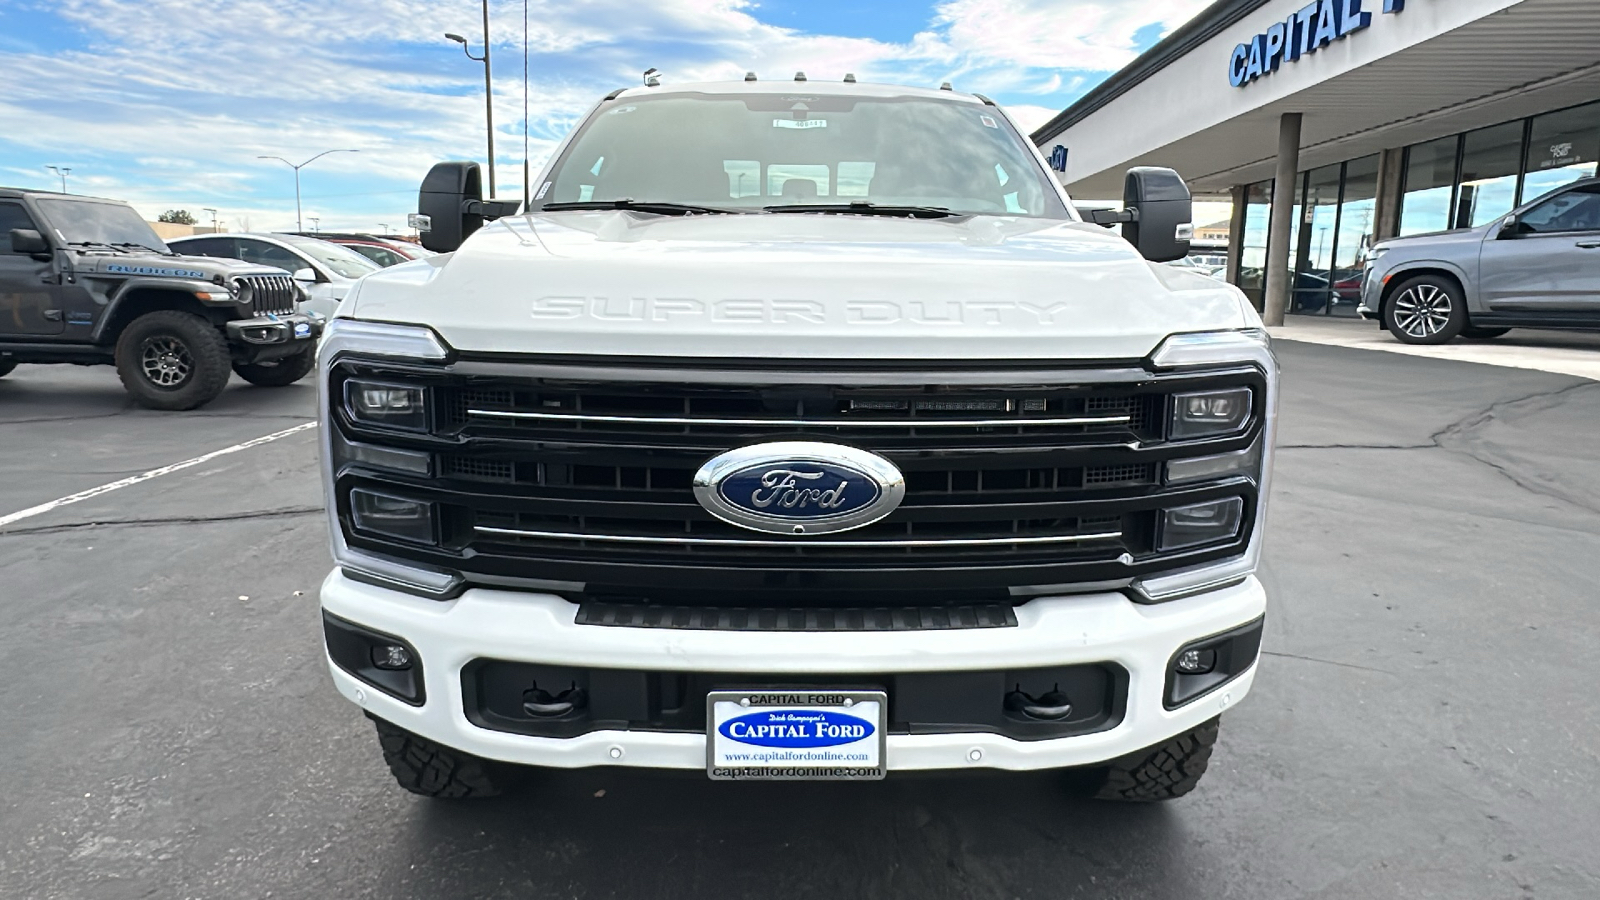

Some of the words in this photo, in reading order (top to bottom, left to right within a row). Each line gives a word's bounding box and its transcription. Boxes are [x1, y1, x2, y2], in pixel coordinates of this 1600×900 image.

[1229, 0, 1371, 88] CAPITAL
[106, 265, 204, 278] RUBICON
[530, 295, 825, 324] SUPER
[846, 300, 1068, 326] DUTY
[751, 468, 848, 509] Ford
[750, 694, 803, 704] CAPITAL
[808, 694, 845, 704] FORD
[725, 751, 869, 762] www.capitalfordonline.com
[712, 766, 882, 779] capitalfordonline.com
